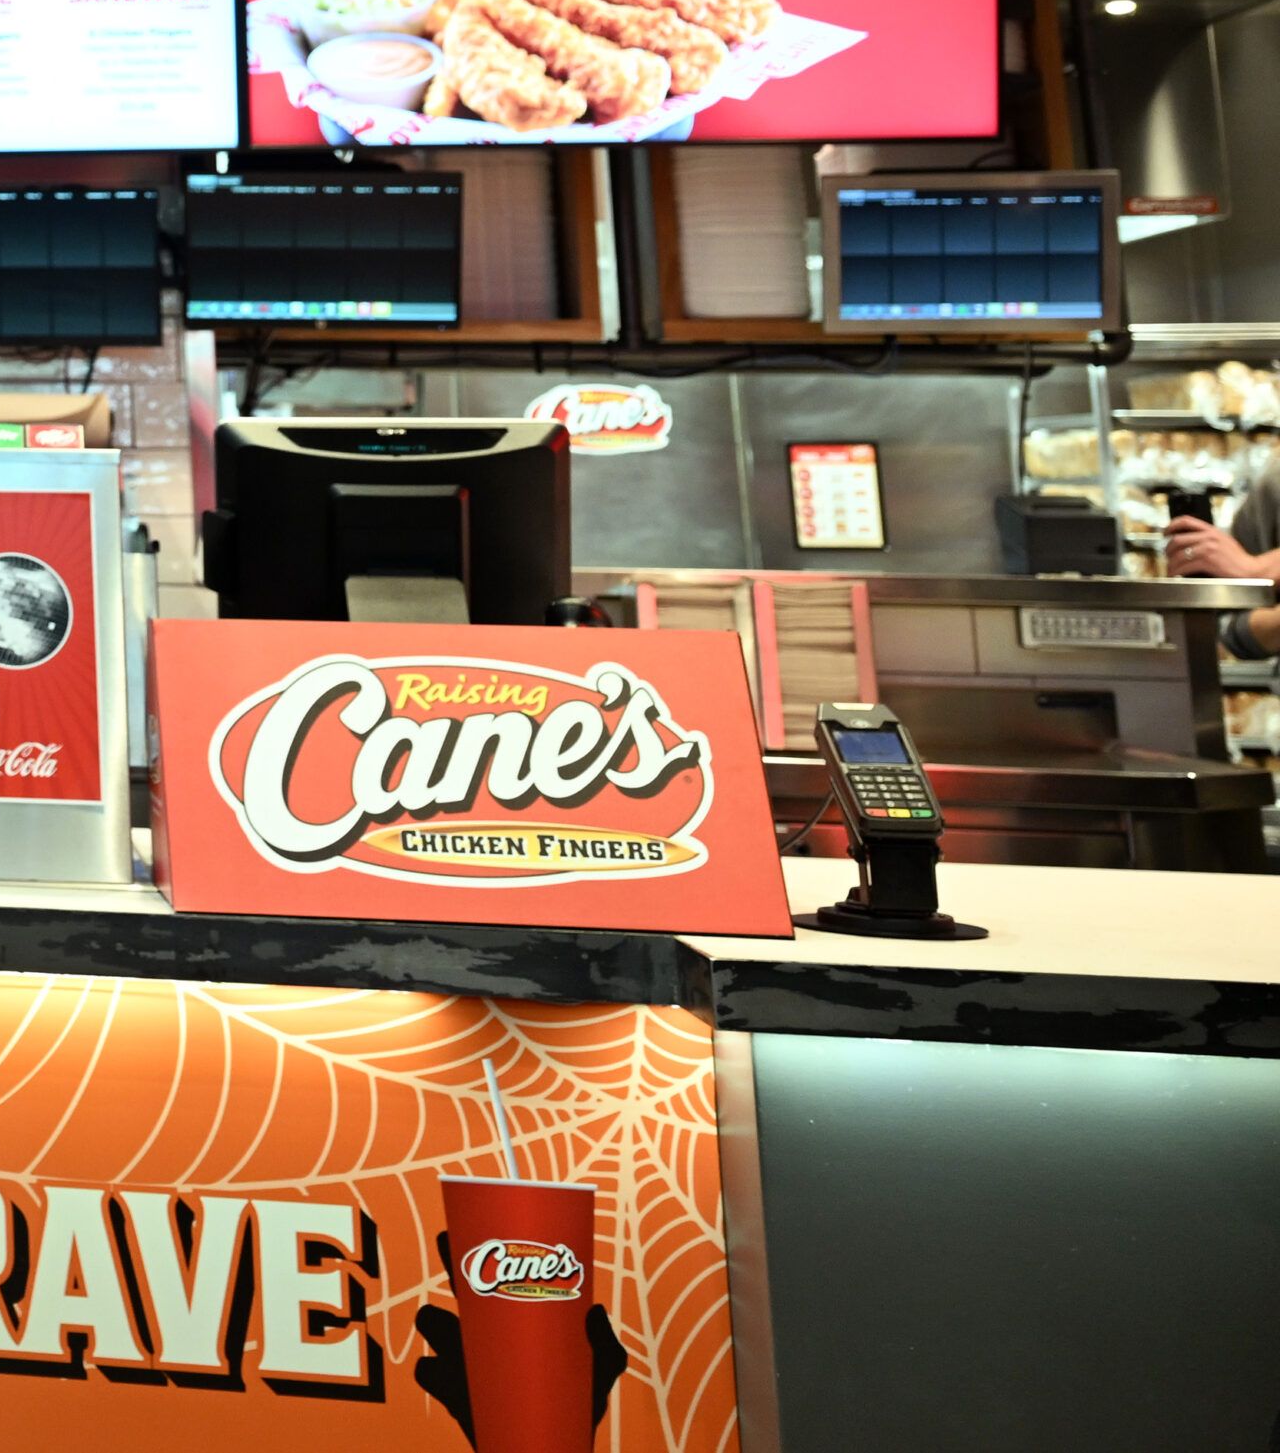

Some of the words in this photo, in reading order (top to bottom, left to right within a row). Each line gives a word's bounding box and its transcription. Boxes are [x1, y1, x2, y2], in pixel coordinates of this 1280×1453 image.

[395, 673, 549, 716] Raising
[243, 662, 700, 862] Cane's
[400, 829, 526, 858] CHICKEN
[536, 832, 666, 863] FINGERS
[469, 1239, 581, 1293] Cane's
